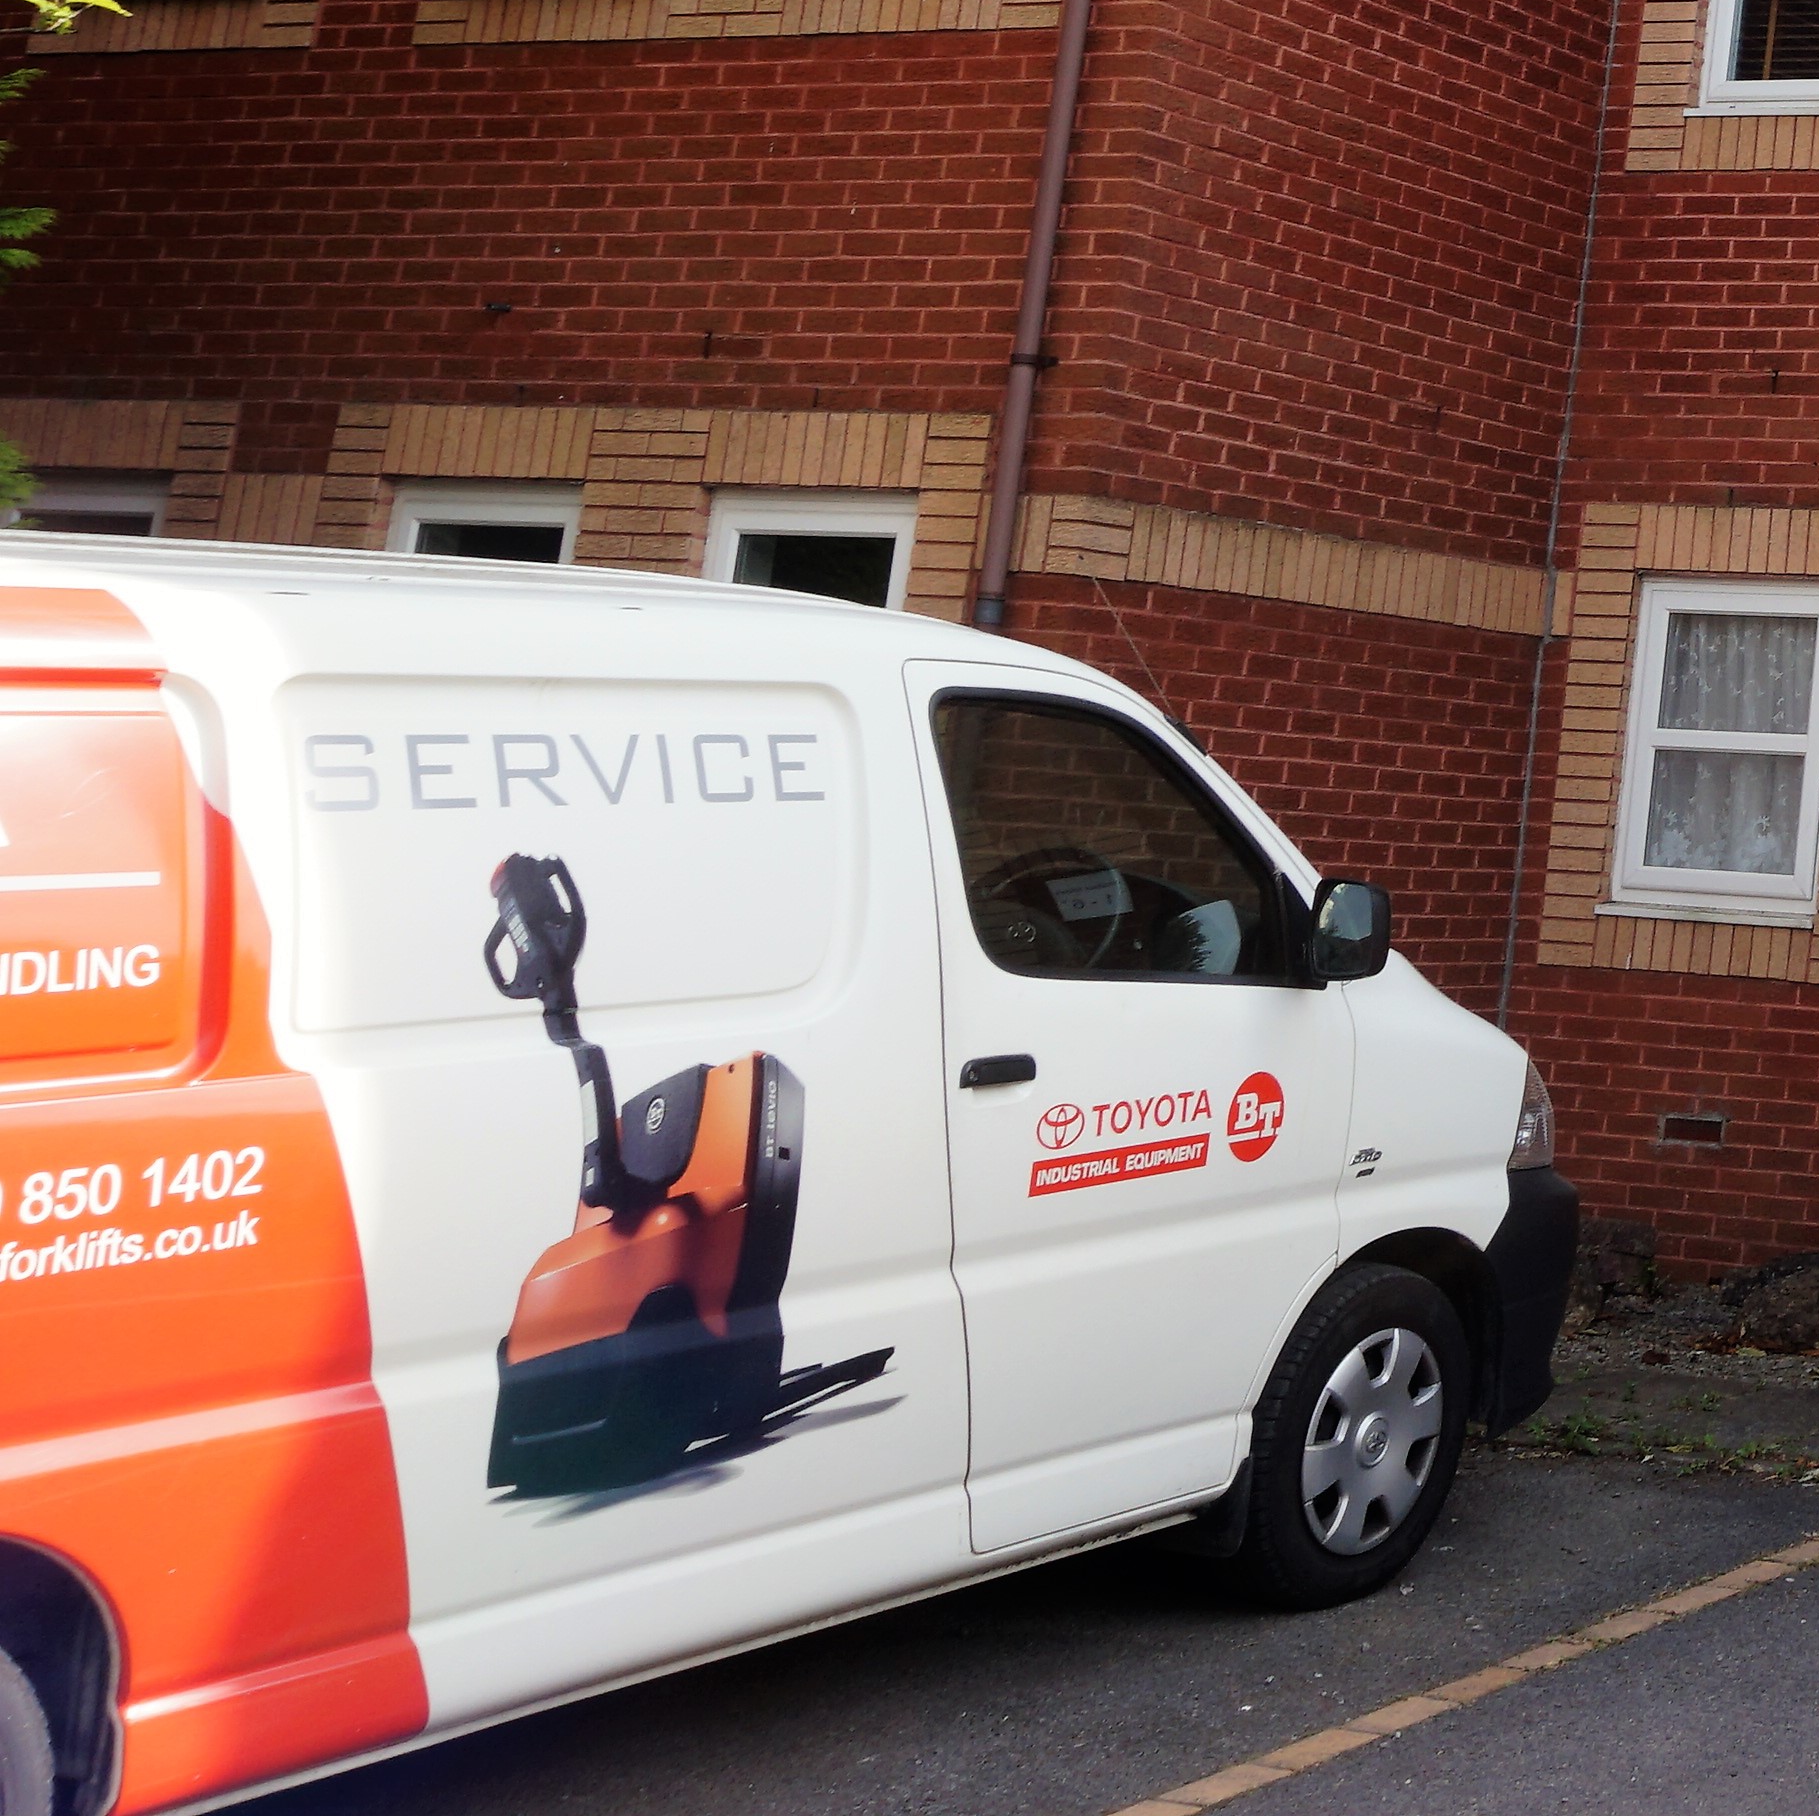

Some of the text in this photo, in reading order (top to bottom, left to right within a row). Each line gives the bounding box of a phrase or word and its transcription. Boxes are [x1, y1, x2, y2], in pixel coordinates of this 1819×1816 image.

[303, 733, 826, 812] SERVICE
[1092, 1089, 1213, 1136] TOYOTA
[1234, 1093, 1281, 1138] BT
[18, 1146, 265, 1224] 850 1402
[1035, 1142, 1205, 1187] INDUSTRIAL EQUIPMENT
